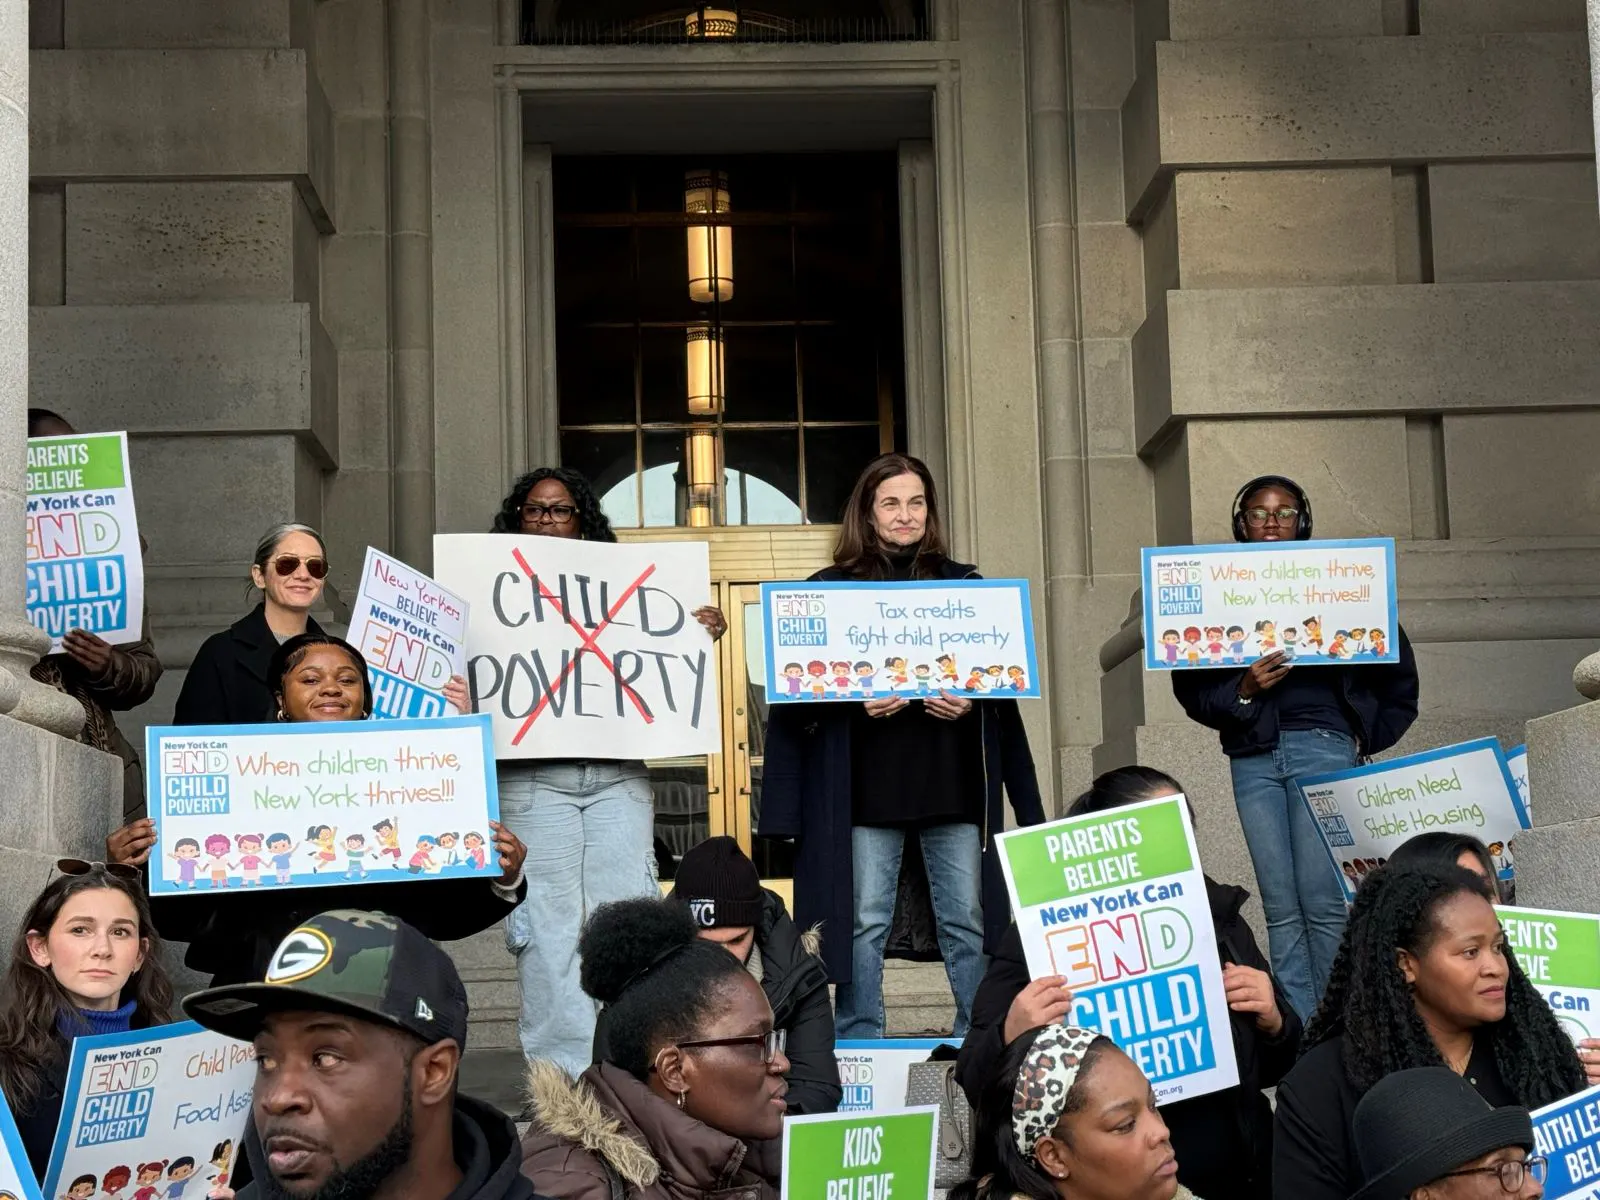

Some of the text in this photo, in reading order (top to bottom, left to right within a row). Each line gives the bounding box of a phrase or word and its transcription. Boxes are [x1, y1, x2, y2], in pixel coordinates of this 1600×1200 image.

[27, 444, 89, 468] ARENTS
[40, 495, 80, 511] York
[83, 494, 115, 508] Can
[1157, 568, 1202, 585] END
[1210, 559, 1376, 581] When children thrive,
[374, 559, 460, 621] New Yorkers
[492, 572, 685, 637] CHILD
[1160, 586, 1201, 602] CHILD
[1223, 584, 1370, 606] New York thrives!!!
[396, 594, 438, 627] BELIEVE
[776, 600, 826, 616] END
[875, 599, 976, 620] Tax credits
[1160, 602, 1201, 615] POVERTY
[370, 605, 455, 655] New York Can
[780, 618, 824, 633] CHILD
[780, 633, 824, 645] POVERTY
[845, 625, 1010, 653] fight child poverty
[360, 620, 453, 690] END
[467, 647, 706, 729] POVERTY
[164, 741, 228, 750] New York Can
[236, 746, 461, 776] When children thrive,
[164, 750, 229, 774] END
[168, 776, 227, 797] CHILD
[254, 779, 455, 810] New York thrives!!!
[1357, 767, 1462, 808] Children Need
[168, 797, 227, 814] POVERTY
[1364, 803, 1485, 839] Stable Housing
[1045, 817, 1142, 863] PARENTS
[1064, 852, 1142, 892] BELIEVE
[1040, 881, 1184, 926] New York Can
[1045, 906, 1194, 989] END
[1504, 919, 1558, 950] ENTS
[1068, 973, 1200, 1039] CHILD
[1549, 991, 1590, 1011] Can
[94, 1046, 162, 1063] New York Can
[186, 1046, 227, 1078] Child
[1126, 1026, 1204, 1078] ERTY
[87, 1058, 159, 1095] END
[839, 1064, 874, 1084] ND
[84, 1090, 151, 1123] CHILD
[173, 1094, 223, 1129] Food
[79, 1116, 146, 1145] POVERTY
[1530, 1113, 1578, 1156] AITH
[843, 1125, 884, 1168] KIDS
